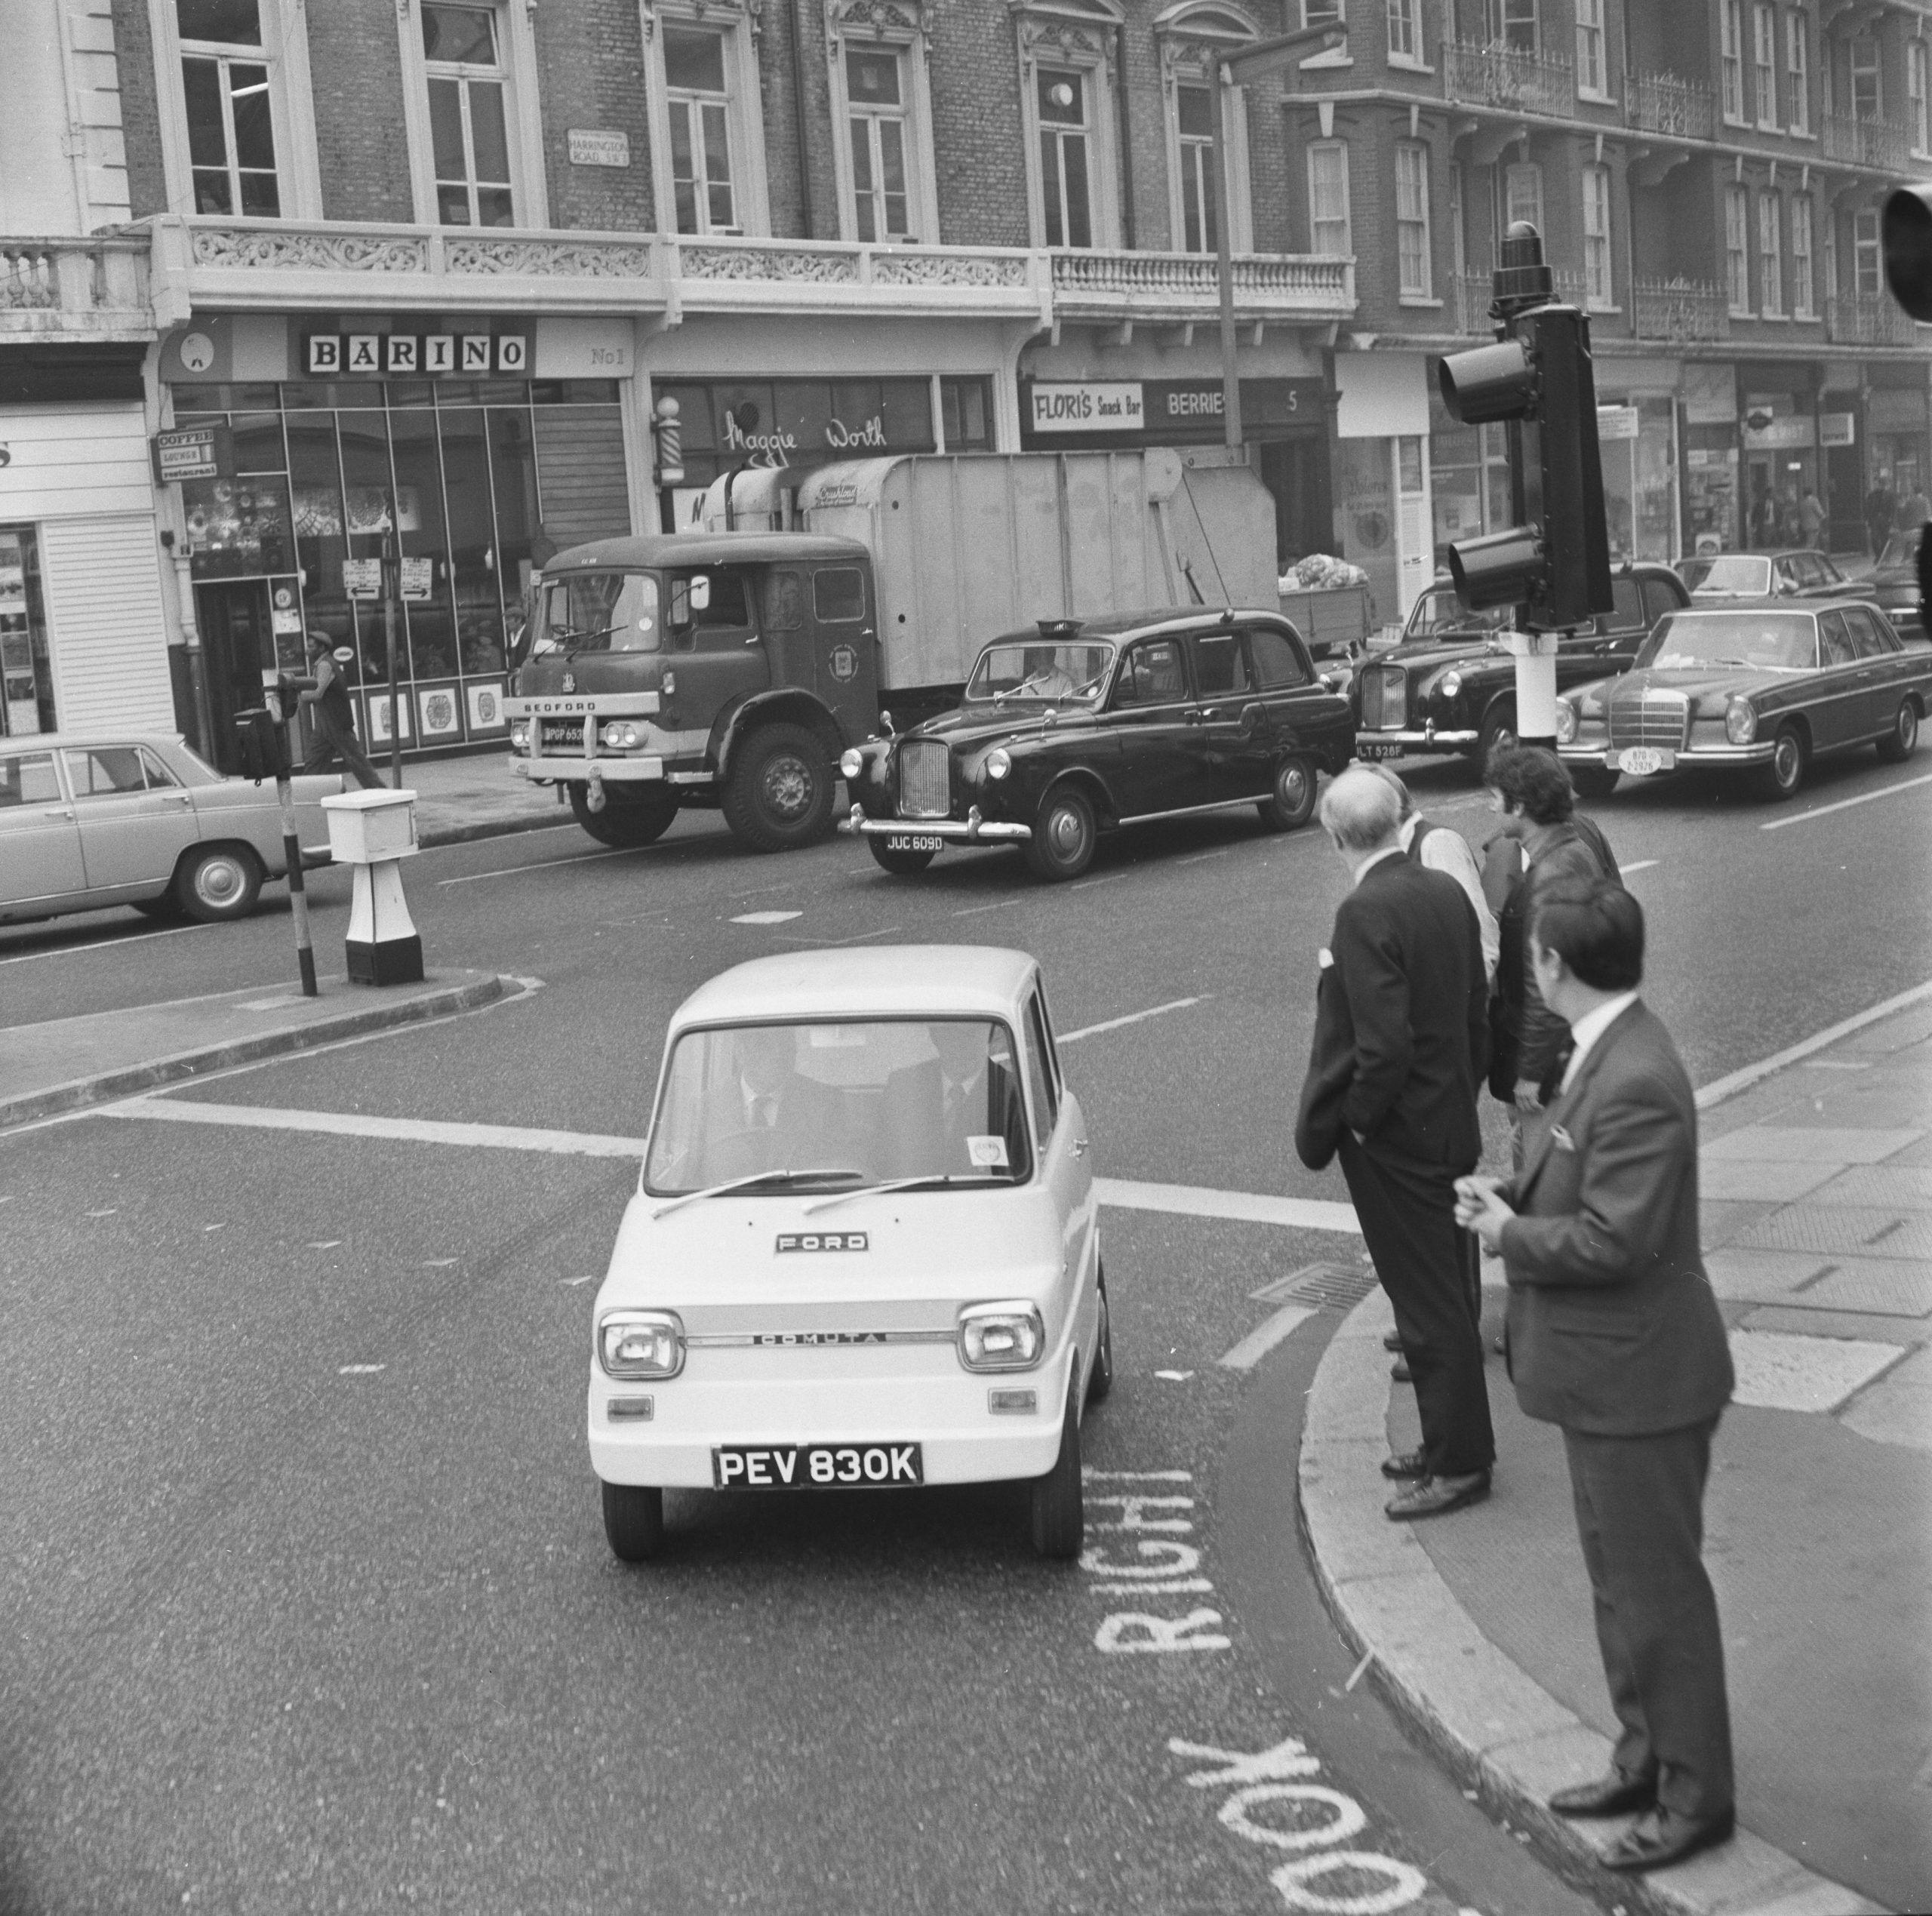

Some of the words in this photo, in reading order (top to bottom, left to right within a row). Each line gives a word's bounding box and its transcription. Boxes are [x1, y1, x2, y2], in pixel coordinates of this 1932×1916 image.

[570, 140, 629, 152] HARRINGTON
[574, 151, 600, 162] ROAD
[314, 340, 521, 366] BARINO
[1034, 389, 1092, 420] FLORI'S
[1097, 395, 1121, 416] Snack
[1125, 395, 1141, 415] Bar
[1167, 392, 1226, 415] BERRIE
[1287, 390, 1297, 411] 5
[159, 431, 212, 446] COFFEE
[722, 410, 797, 469] Maggie
[826, 416, 888, 447] Worth
[525, 702, 595, 712] BEDFORD
[550, 728, 565, 740] PGP
[566, 727, 583, 740] 653
[888, 835, 911, 850] JUC
[912, 836, 943, 850] 609D
[779, 1235, 866, 1250] FORD
[719, 1450, 797, 1484] PEV
[809, 1446, 917, 1482] 830K
[1168, 1736, 1481, 1916] OOK
